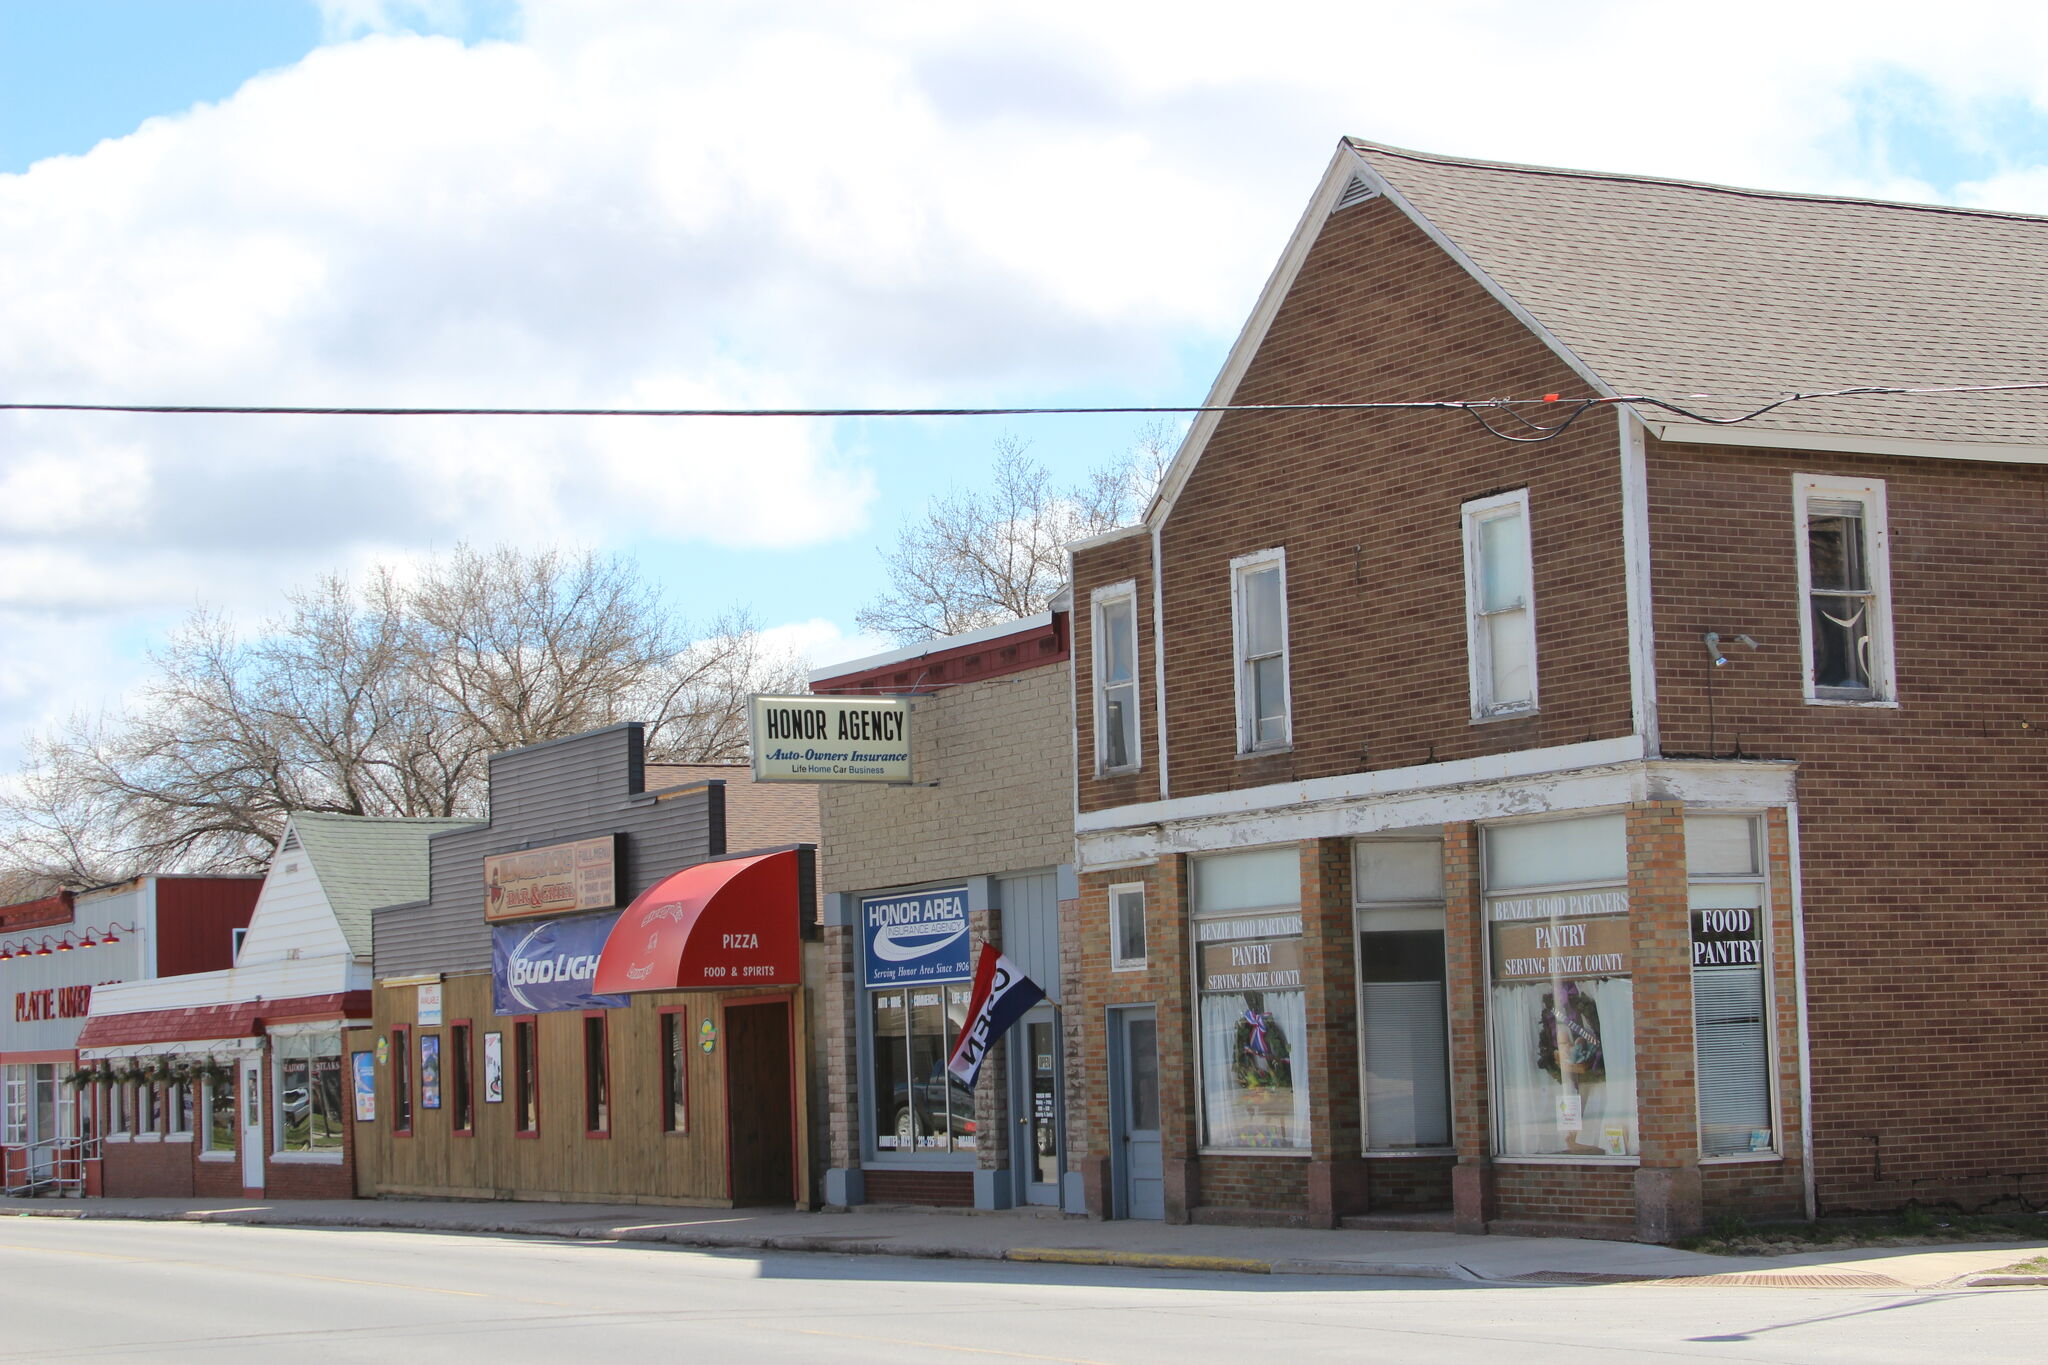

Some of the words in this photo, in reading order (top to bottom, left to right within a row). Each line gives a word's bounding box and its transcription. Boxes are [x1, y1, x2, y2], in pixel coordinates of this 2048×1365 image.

[767, 708, 827, 740] HONOR
[838, 710, 904, 741] AGENCY
[766, 749, 849, 761] Auto-Owners
[850, 751, 908, 762] Insurance
[792, 764, 807, 773] Life
[808, 764, 832, 773] Home
[833, 765, 847, 774] Car
[849, 765, 885, 775] Business
[869, 901, 920, 927] HONOR
[923, 896, 964, 921] AREA
[1495, 899, 1533, 921] BENZIE
[1537, 897, 1566, 918] FOOD
[1569, 892, 1630, 915] PARTNERS
[887, 925, 929, 937] INSURANCE
[931, 922, 961, 933] AGENCY
[1200, 921, 1230, 941] BENZIE
[1232, 919, 1256, 938] FOOD
[1701, 909, 1750, 932] FOOD
[722, 933, 759, 949] PIZZA
[1535, 924, 1587, 949] PANTRY
[1231, 944, 1272, 967] PANTRY
[1693, 940, 1762, 964] PANTRY
[513, 958, 554, 986] BUD
[554, 953, 602, 982] LIGH
[704, 966, 726, 977] FOOD
[731, 966, 738, 977] &
[743, 966, 775, 976] SPIRITS
[874, 968, 896, 979] Serving
[898, 966, 918, 977] Honor
[919, 964, 934, 975] Area
[936, 963, 952, 974] Since
[955, 961, 970, 972] 1906
[1505, 957, 1546, 976] SERVING
[1548, 955, 1582, 974] BENZIE
[1585, 953, 1623, 972] COUNTY
[1208, 973, 1240, 990] SERVING
[1241, 971, 1269, 988] BENZIE
[1270, 969, 1300, 986] COUNTY
[16, 988, 56, 1022] PLATTE
